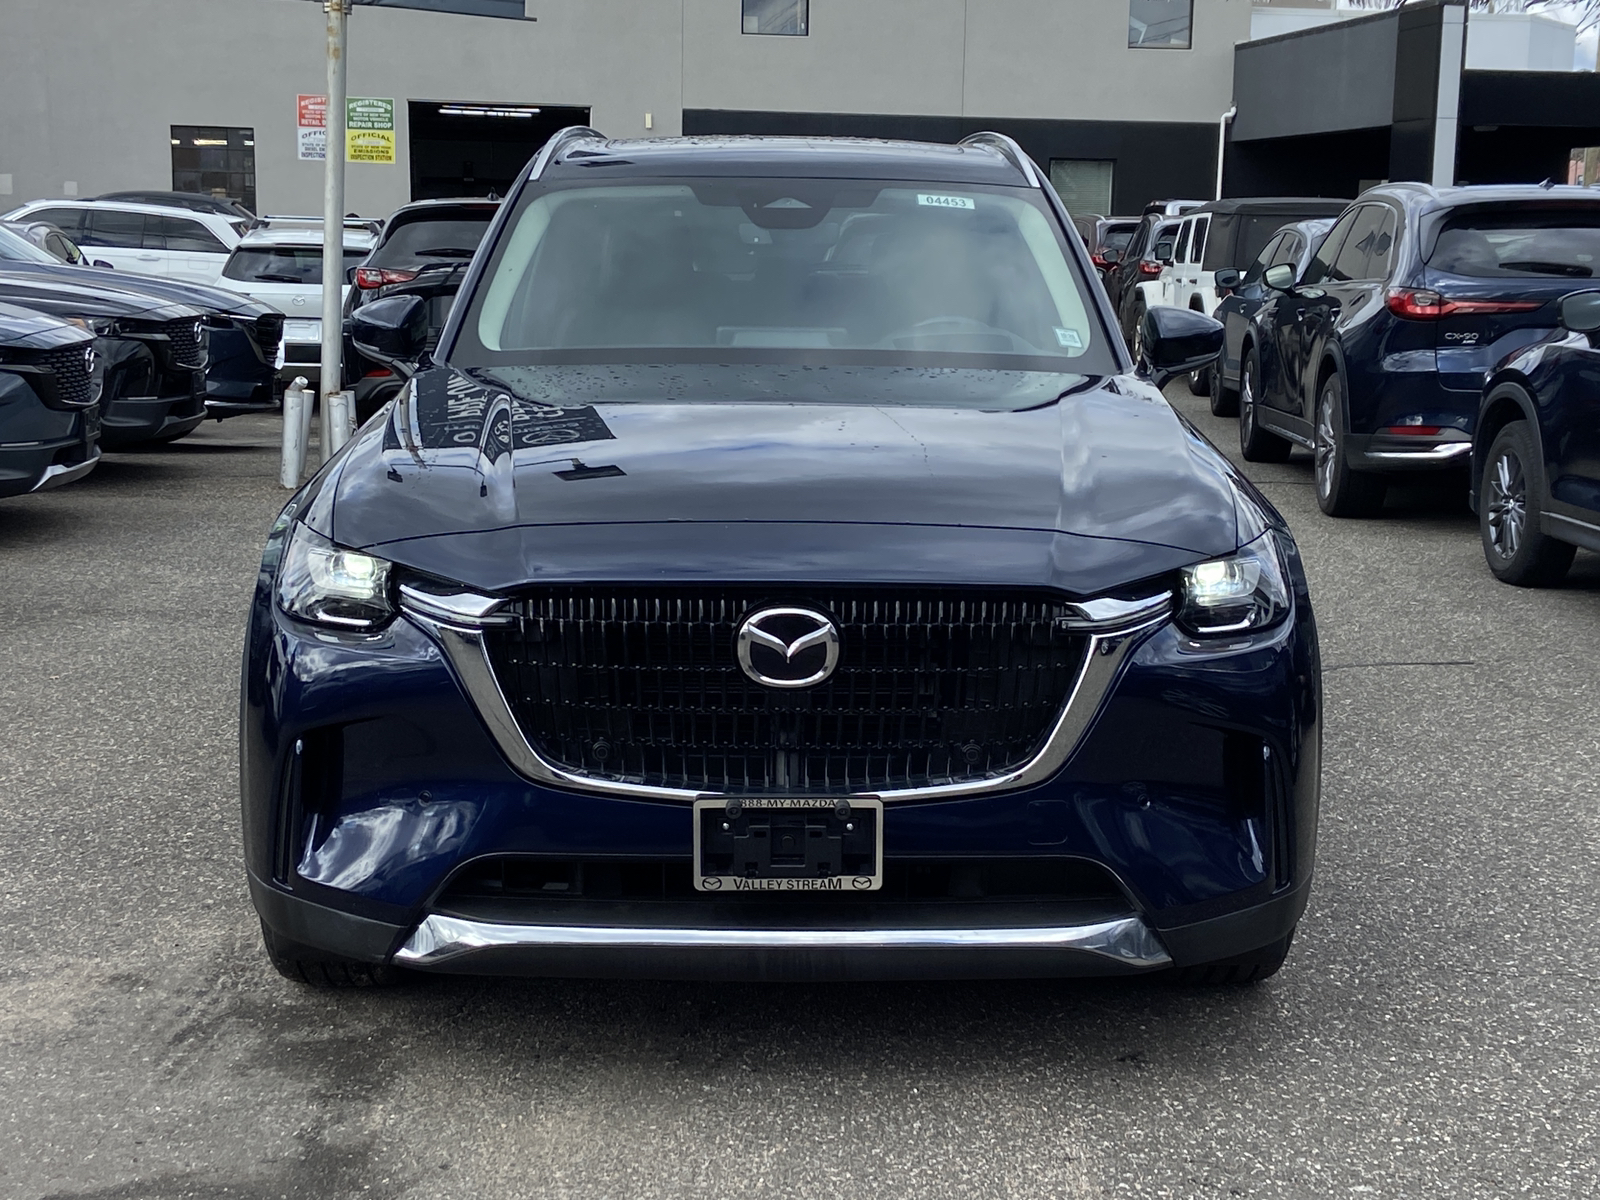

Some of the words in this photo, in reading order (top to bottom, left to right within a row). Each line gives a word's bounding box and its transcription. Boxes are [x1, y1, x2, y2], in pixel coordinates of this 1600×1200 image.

[301, 97, 326, 106] REGIST
[349, 100, 391, 110] REGISTERED
[302, 130, 326, 139] OFFIC
[351, 132, 392, 143] OFFICIAL
[926, 196, 966, 207] 04453
[1444, 332, 1479, 340] CX-90
[733, 878, 783, 890] VALLEY
[786, 878, 842, 890] STREAM
